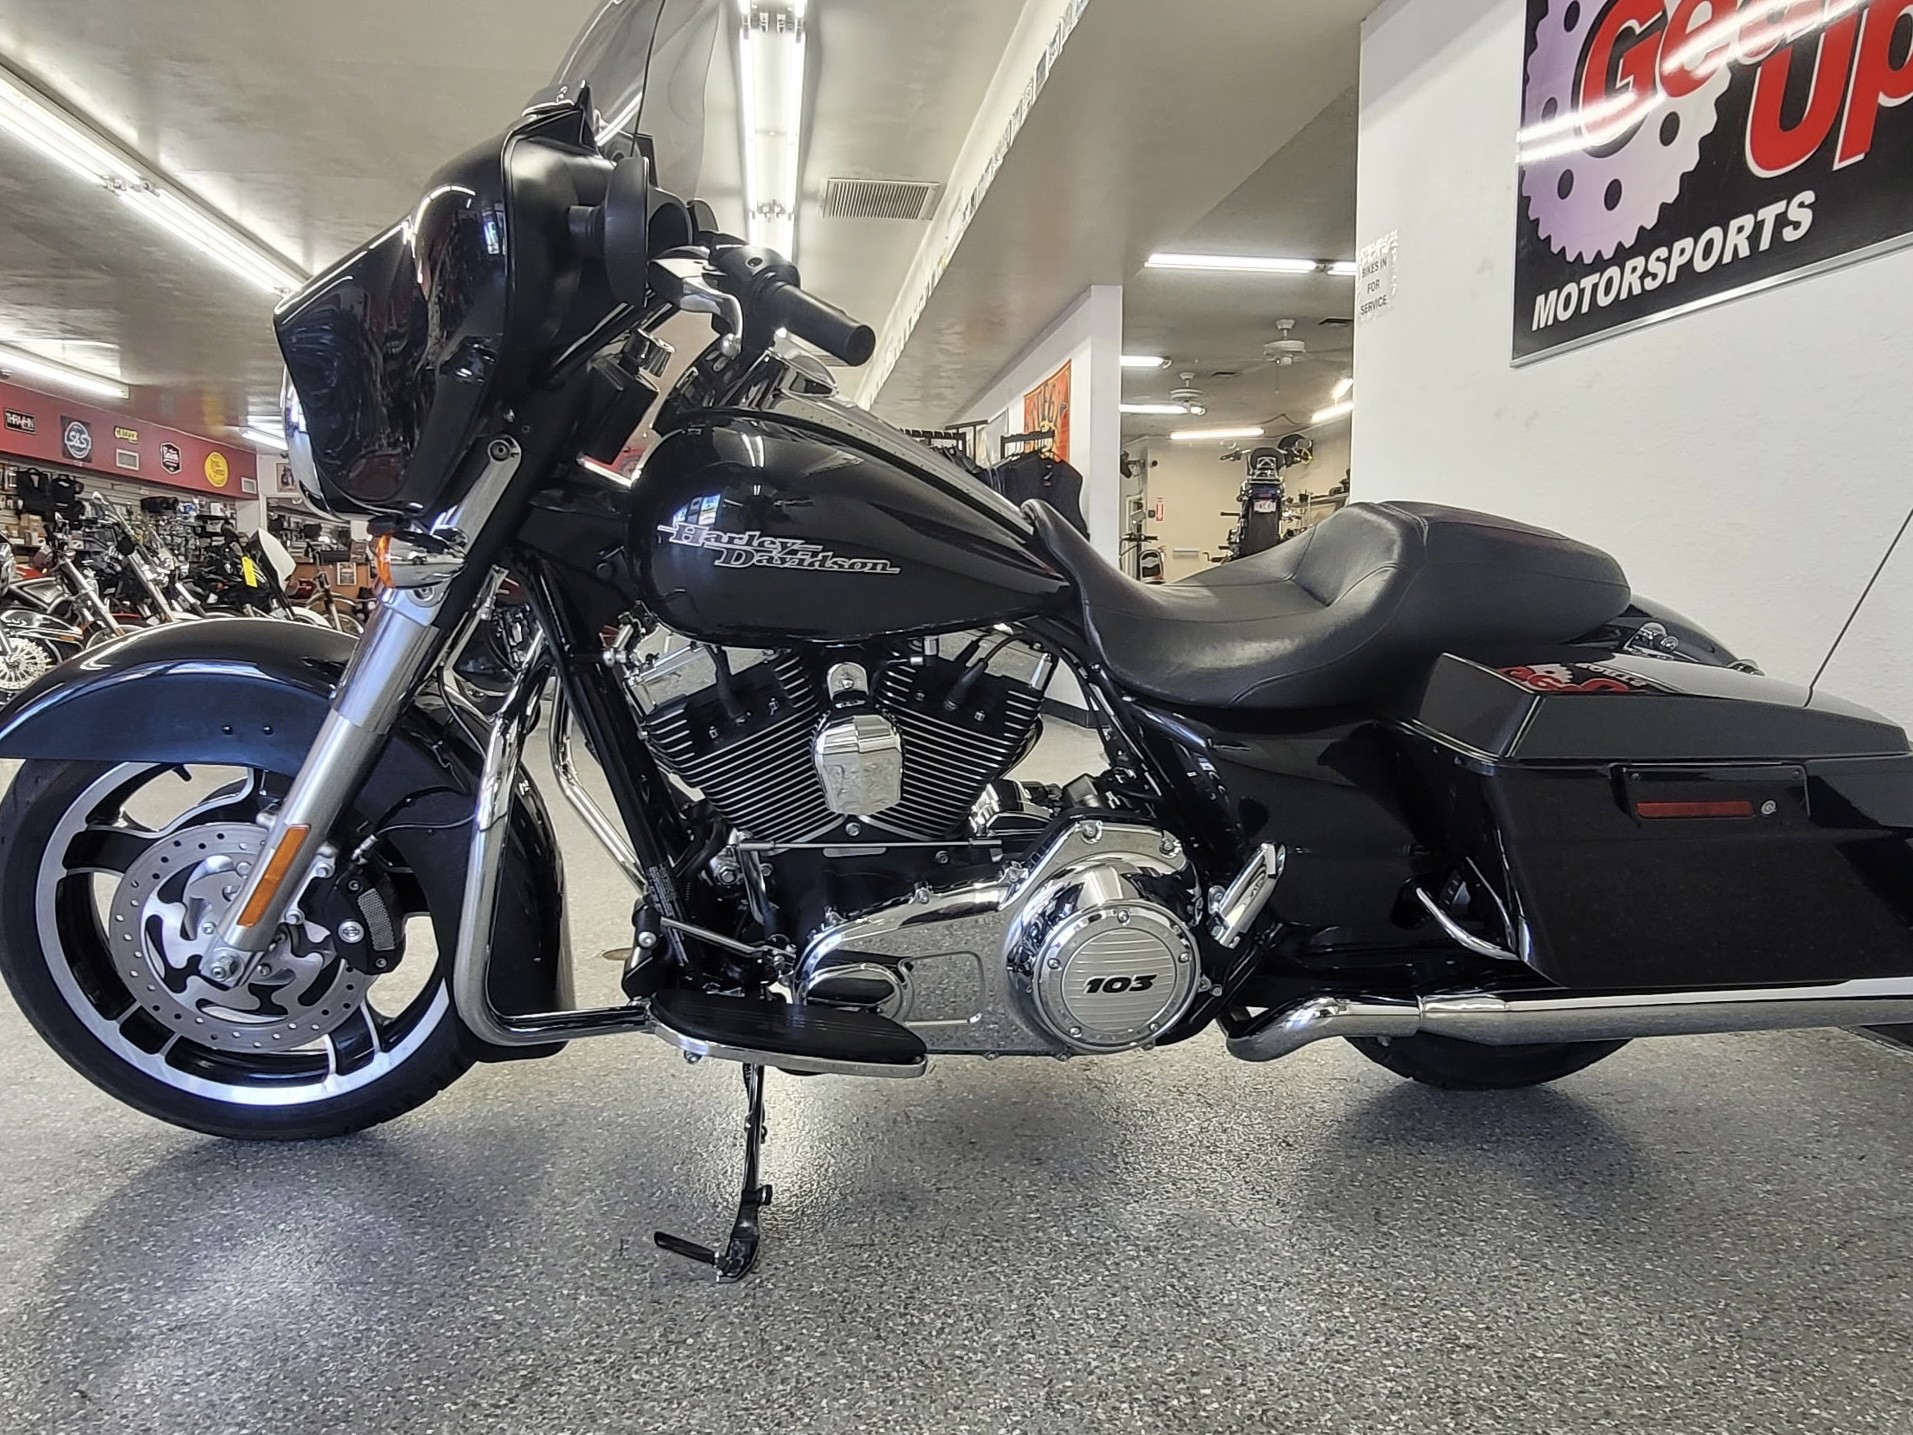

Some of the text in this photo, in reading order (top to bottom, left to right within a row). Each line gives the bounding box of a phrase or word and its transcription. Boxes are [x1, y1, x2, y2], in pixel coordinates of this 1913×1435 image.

[1362, 257, 1387, 279] BIKES IN
[1531, 189, 1816, 331] MOTORSPORTS
[1367, 279, 1380, 294] FOR
[1360, 294, 1387, 315] SERVICE
[713, 547, 901, 574] Davidson
[1083, 973, 1158, 994] 103
